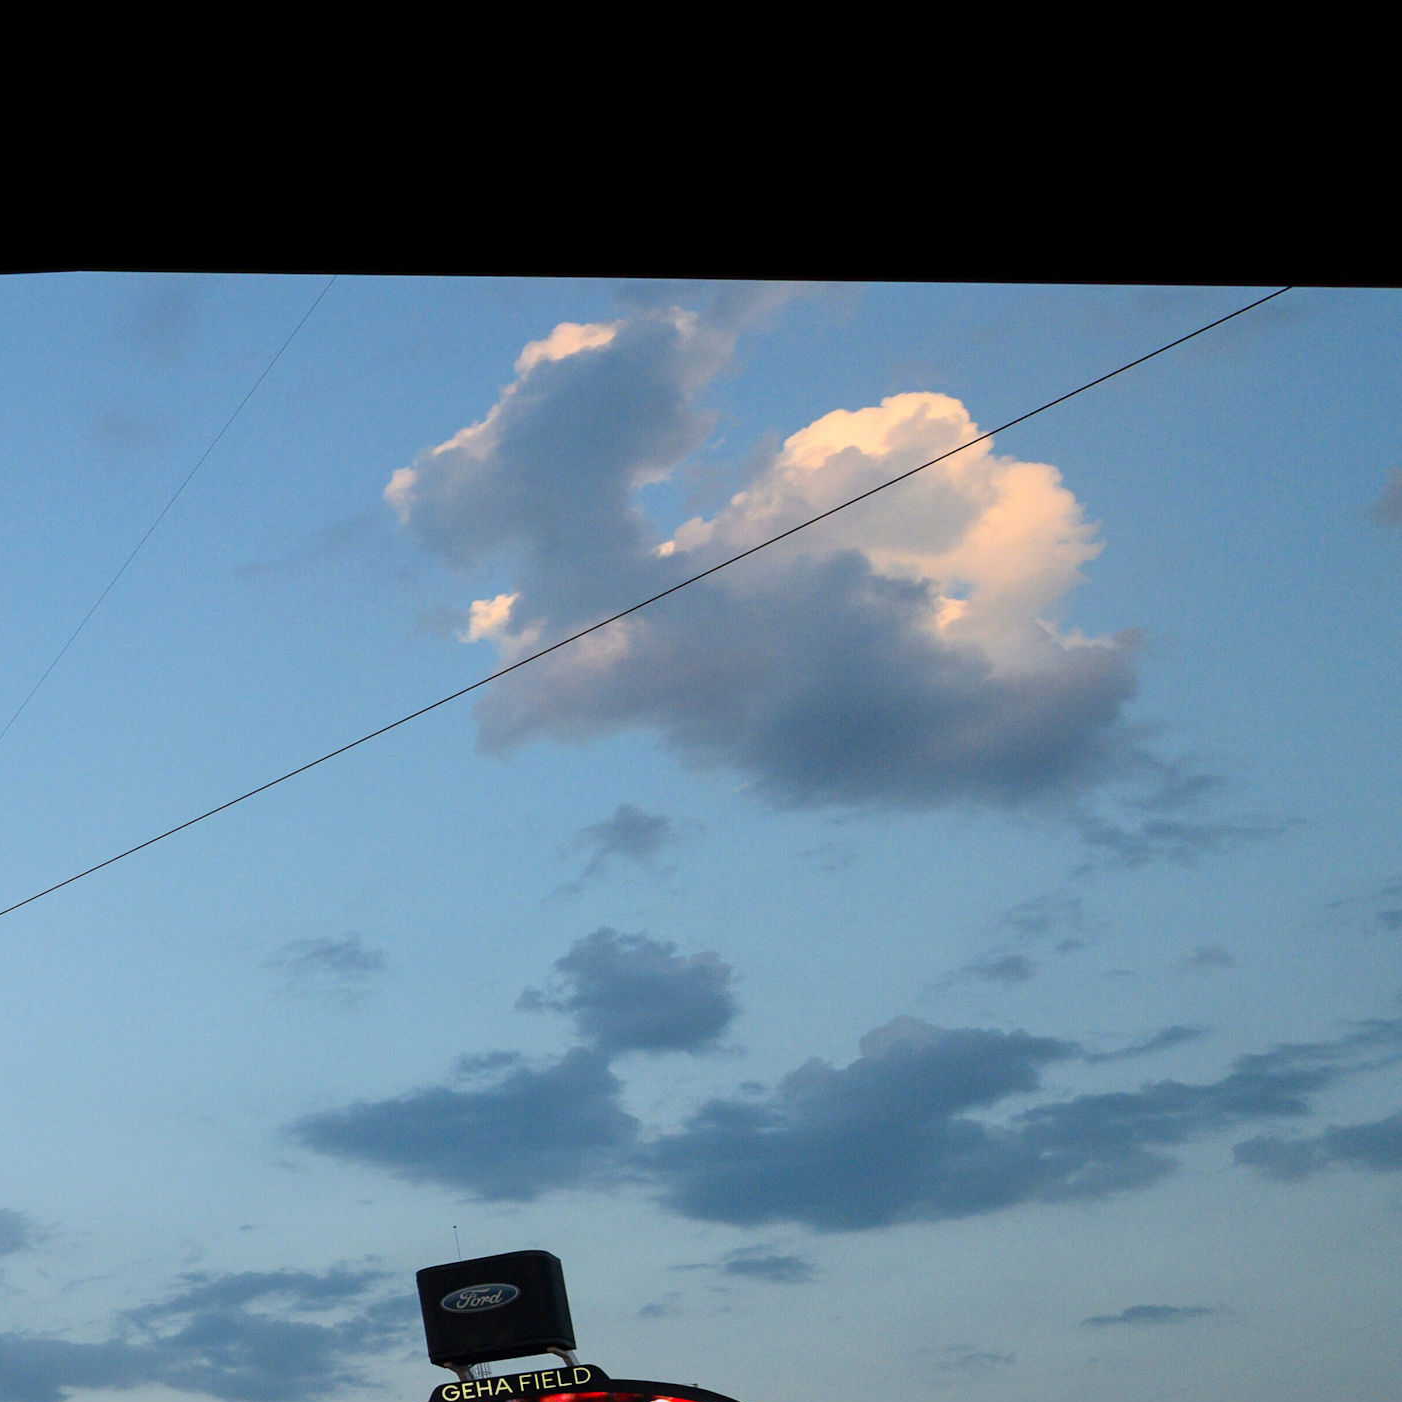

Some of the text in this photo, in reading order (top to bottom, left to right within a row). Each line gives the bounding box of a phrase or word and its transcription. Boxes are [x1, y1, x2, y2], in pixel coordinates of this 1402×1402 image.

[456, 1288, 502, 1309] Ford
[442, 1367, 591, 1402] GEHA FIELD
